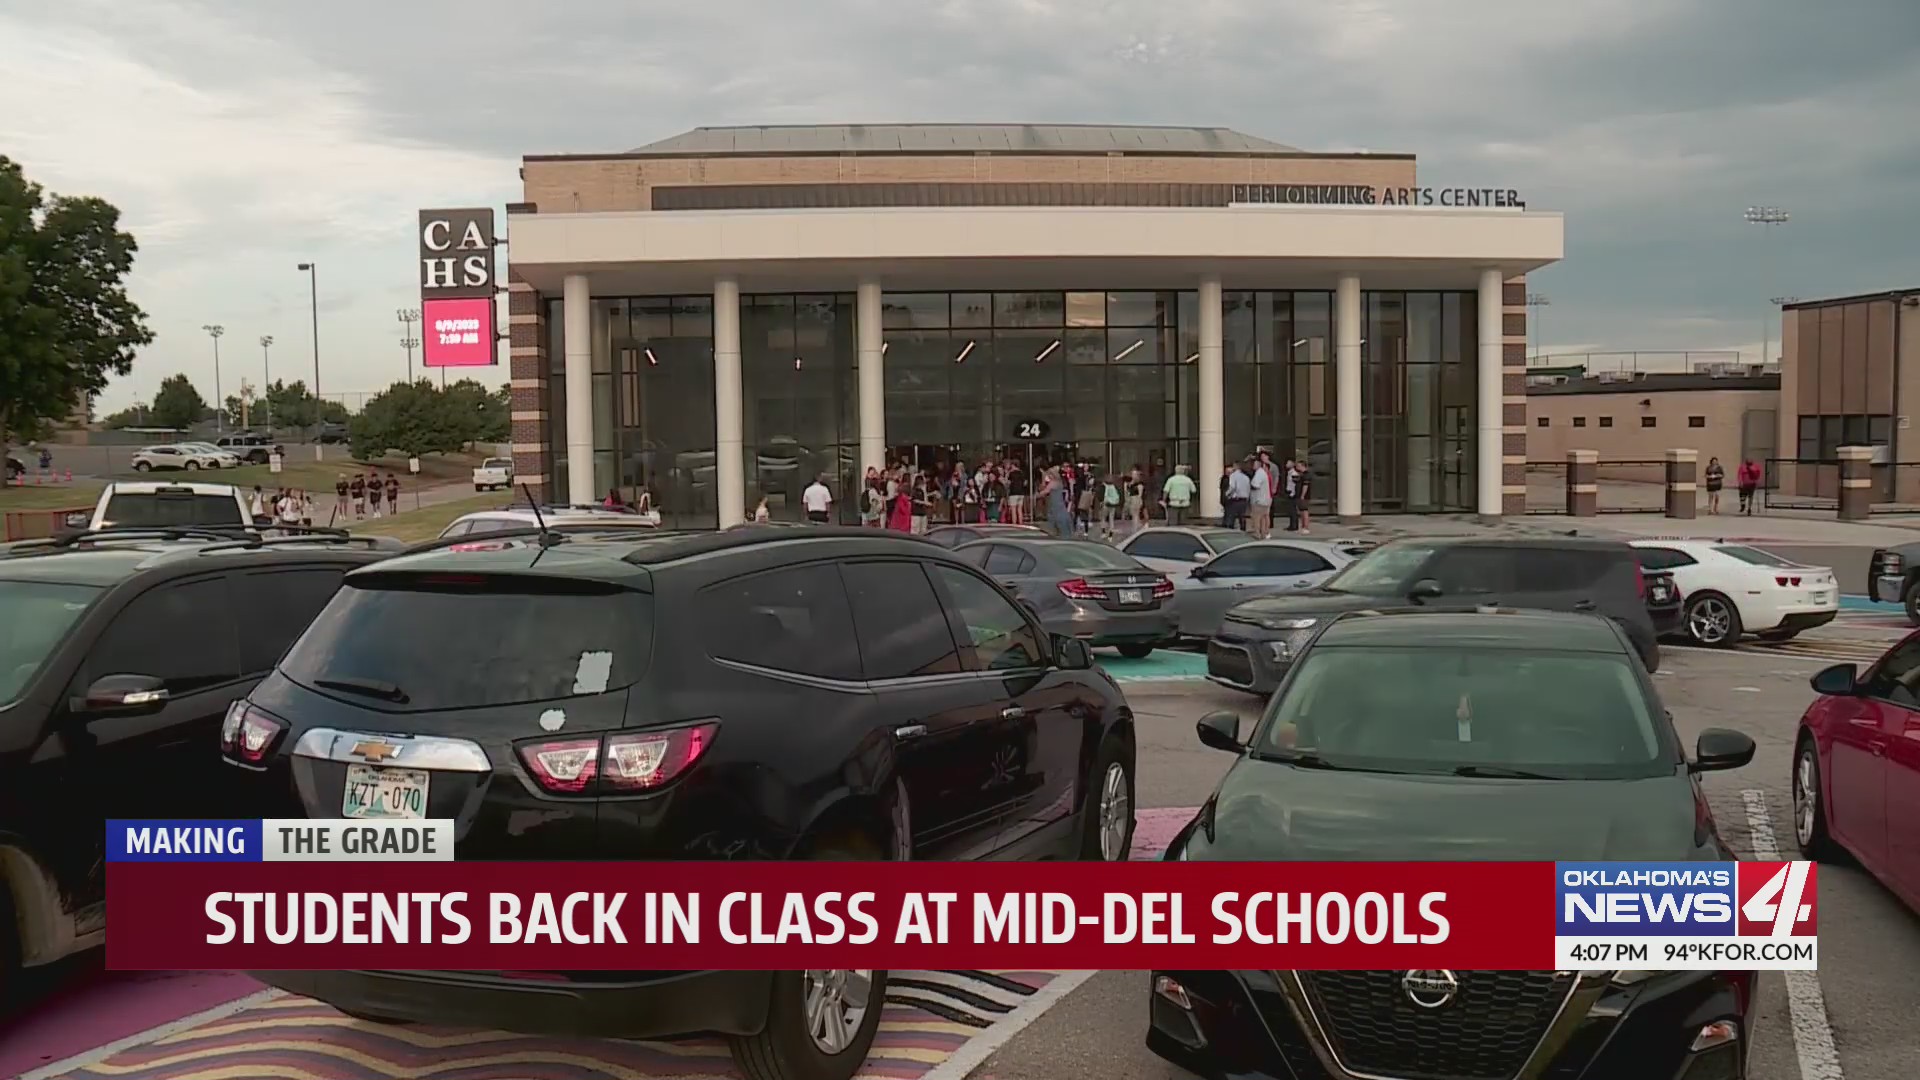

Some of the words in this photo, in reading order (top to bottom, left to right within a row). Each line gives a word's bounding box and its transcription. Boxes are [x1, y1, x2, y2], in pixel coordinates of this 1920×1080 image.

[1382, 187, 1434, 206] ARTS
[1440, 188, 1519, 208] CENTER
[1020, 423, 1040, 437] 24
